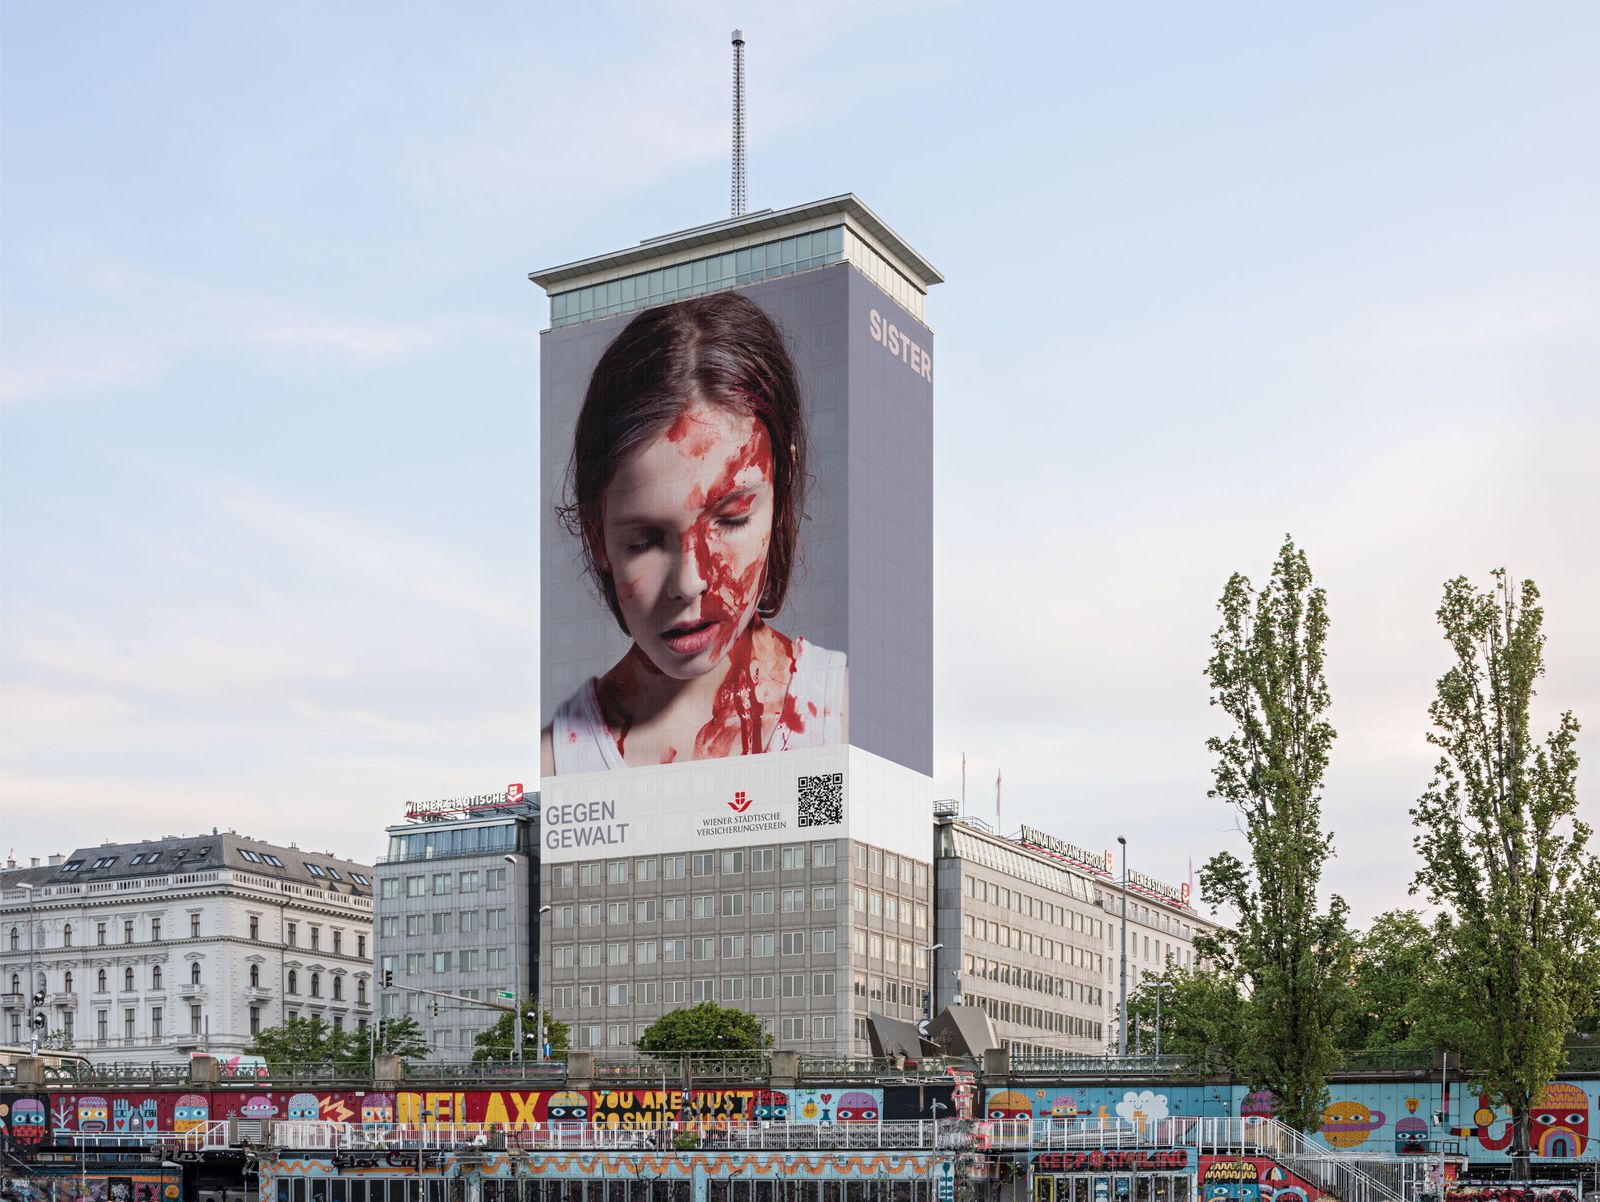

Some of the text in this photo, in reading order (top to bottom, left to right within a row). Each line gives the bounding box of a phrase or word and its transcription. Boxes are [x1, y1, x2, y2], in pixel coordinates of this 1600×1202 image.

[869, 308, 932, 384] SISTER
[405, 799, 443, 814] WIENER
[546, 799, 615, 826] GEGEN
[696, 821, 787, 836] VERSICHERUNGSVEREIN
[702, 816, 733, 826] WIENER
[546, 823, 630, 850] GEWALT
[592, 1090, 753, 1110] YOU ARE JUST
[397, 1092, 541, 1131] RELAX
[591, 1111, 675, 1131] COSMIC
